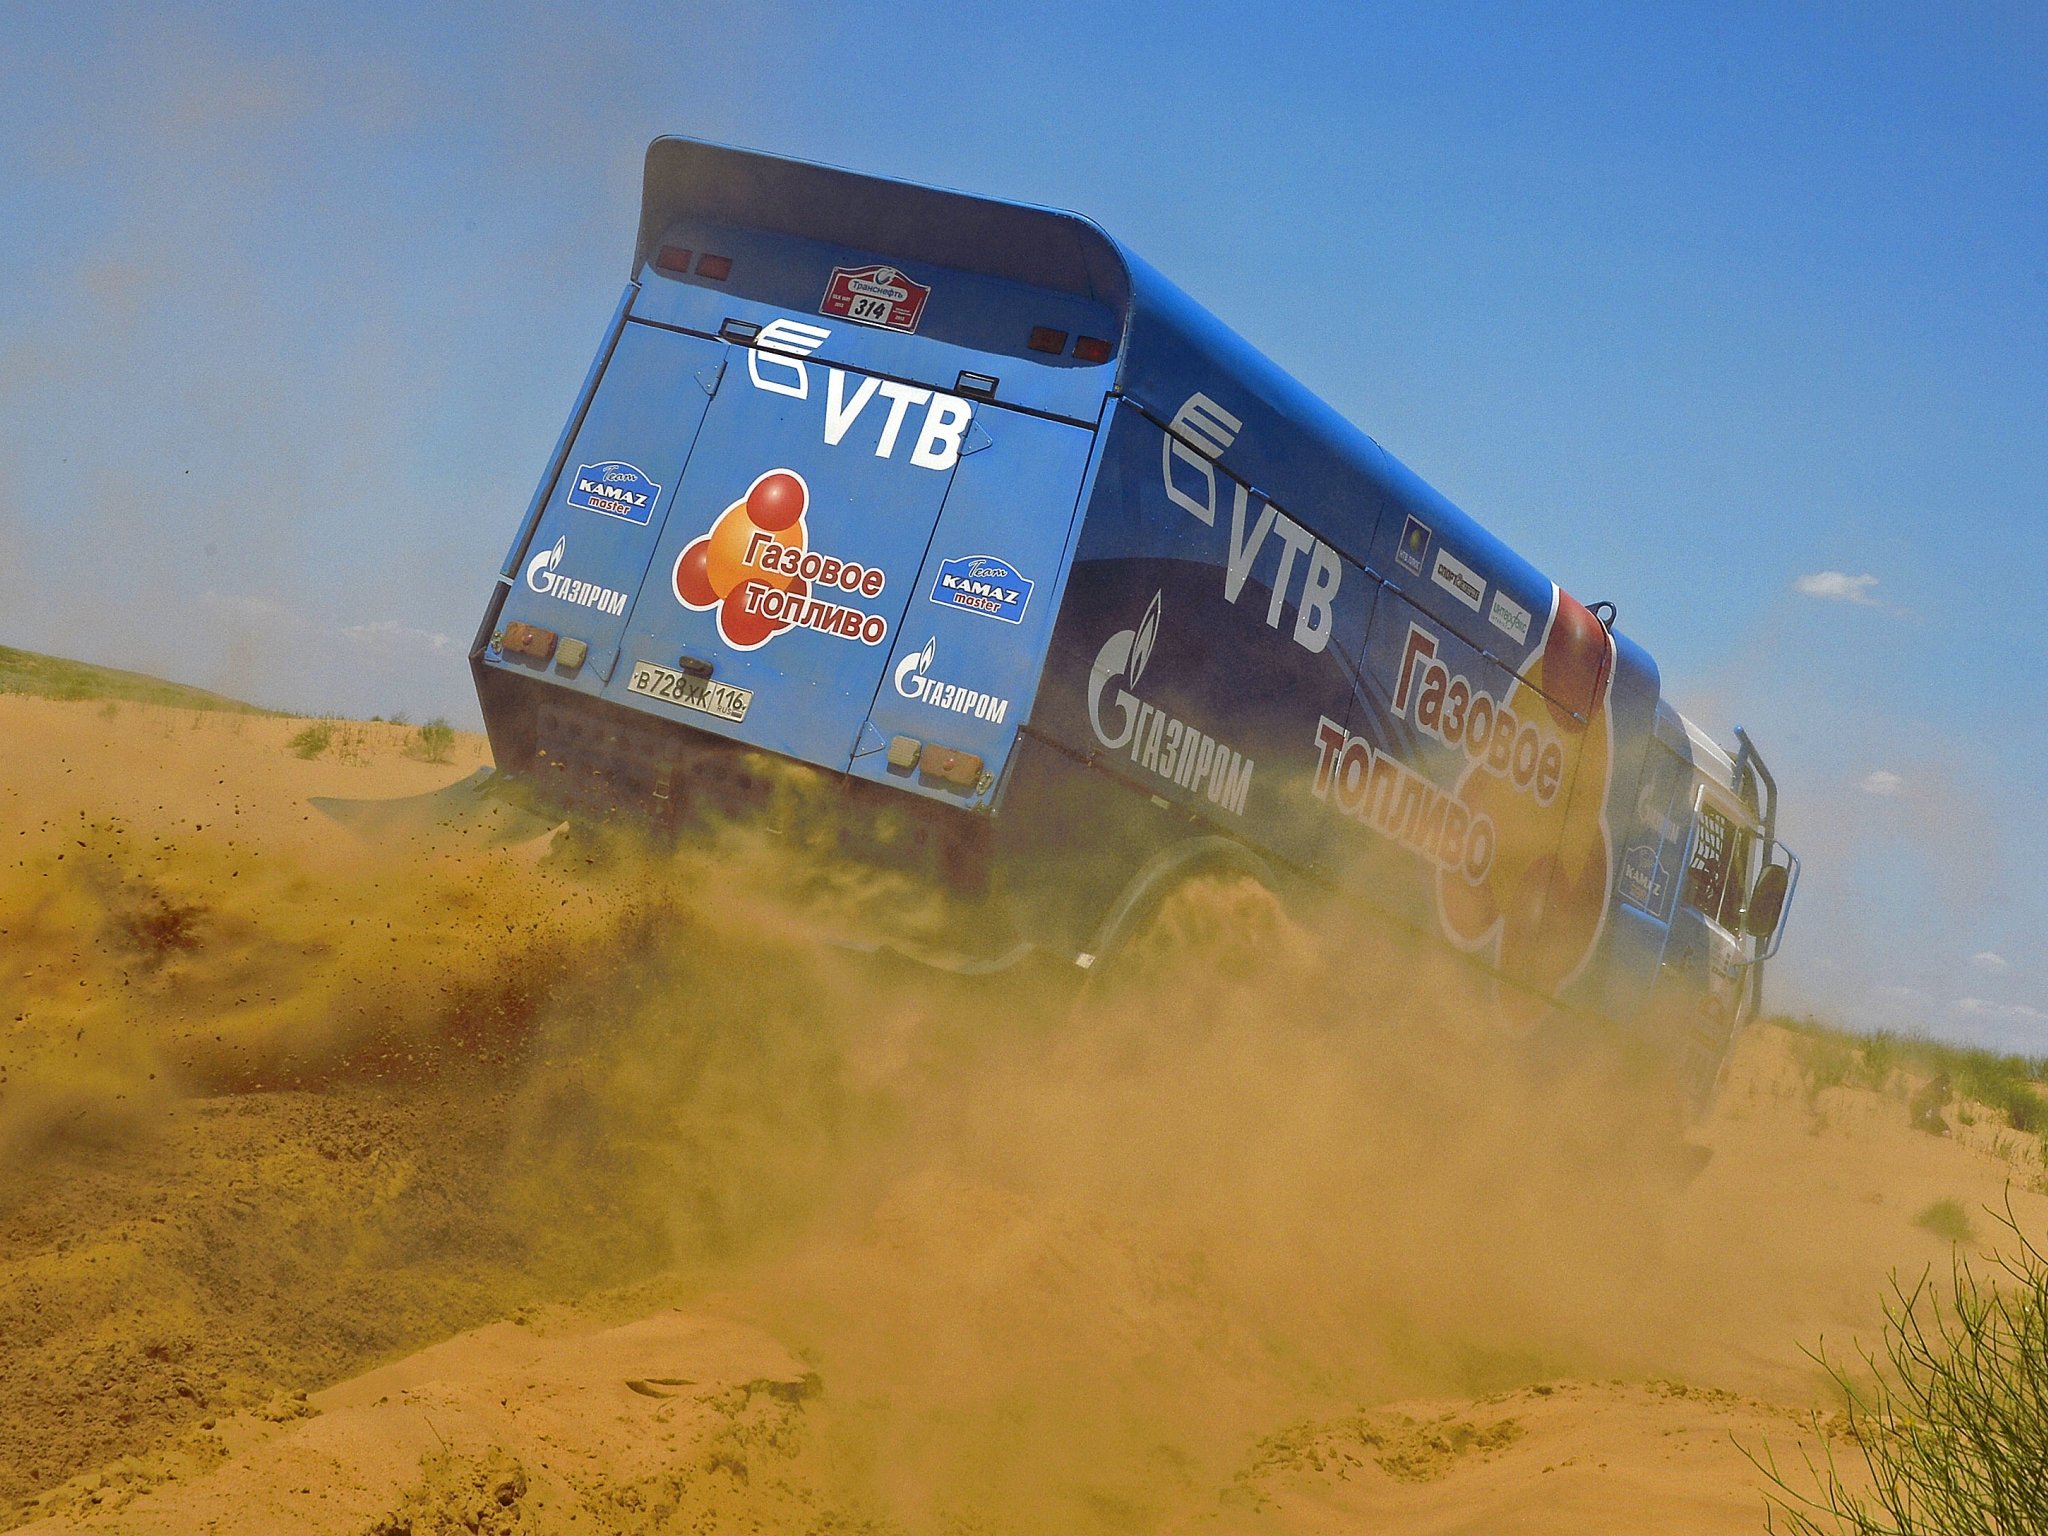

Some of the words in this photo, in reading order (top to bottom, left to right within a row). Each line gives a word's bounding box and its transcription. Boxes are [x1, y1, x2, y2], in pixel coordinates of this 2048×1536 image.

[852, 281, 904, 299] Транснефть
[854, 299, 886, 320] 314
[824, 368, 972, 471] VTB
[602, 465, 638, 482] Team
[579, 479, 648, 507] KAMAZ
[588, 496, 631, 515] master
[742, 531, 885, 598] Газовое
[969, 560, 1007, 577] Team
[1224, 483, 1342, 653] VTB
[550, 575, 628, 616] ГАЗПРОМ
[942, 574, 1019, 604] KAMAZ
[953, 593, 1002, 613] master
[716, 688, 744, 709] 116
[717, 706, 732, 715] RUS
[922, 679, 1008, 724] ГАЗПРОМ
[1391, 621, 1564, 807] Газовое
[1131, 702, 1254, 816] ГАЗПРОМ
[1625, 864, 1661, 896] KAMZ
